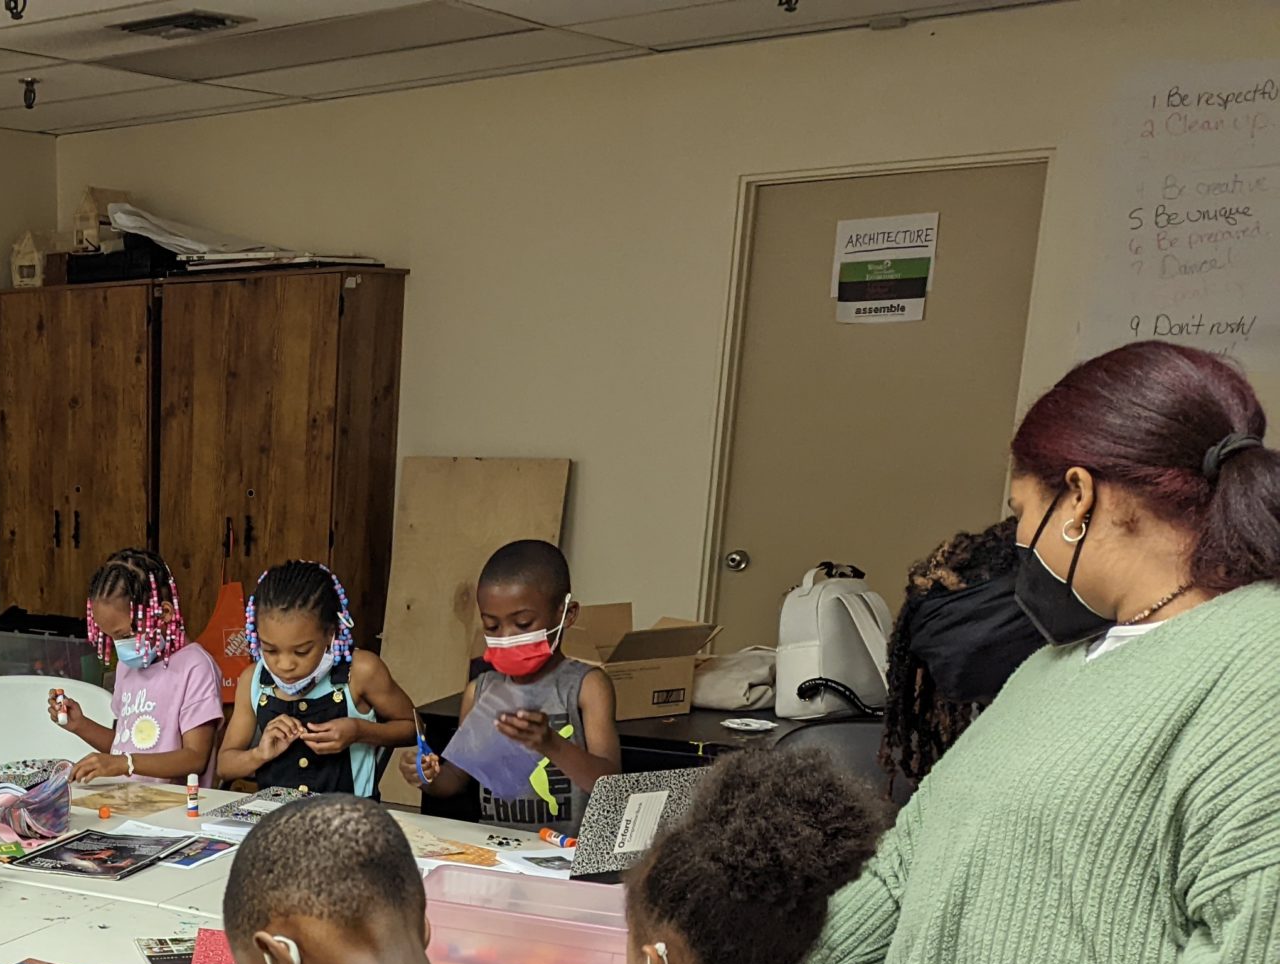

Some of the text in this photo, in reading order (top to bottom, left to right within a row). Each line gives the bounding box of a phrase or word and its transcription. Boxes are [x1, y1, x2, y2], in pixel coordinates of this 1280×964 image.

[1167, 86, 1191, 108] Be
[1197, 79, 1280, 110] respectfu
[1140, 119, 1154, 138] 2
[1165, 112, 1223, 136] Clean
[1129, 204, 1253, 230] 5 Be unique
[845, 228, 934, 248] ARCHITECTURE
[855, 304, 906, 315] assemble
[1130, 313, 1256, 341] 9 Don't rush!
[121, 688, 156, 717] Hello
[617, 819, 632, 849] Oxford
